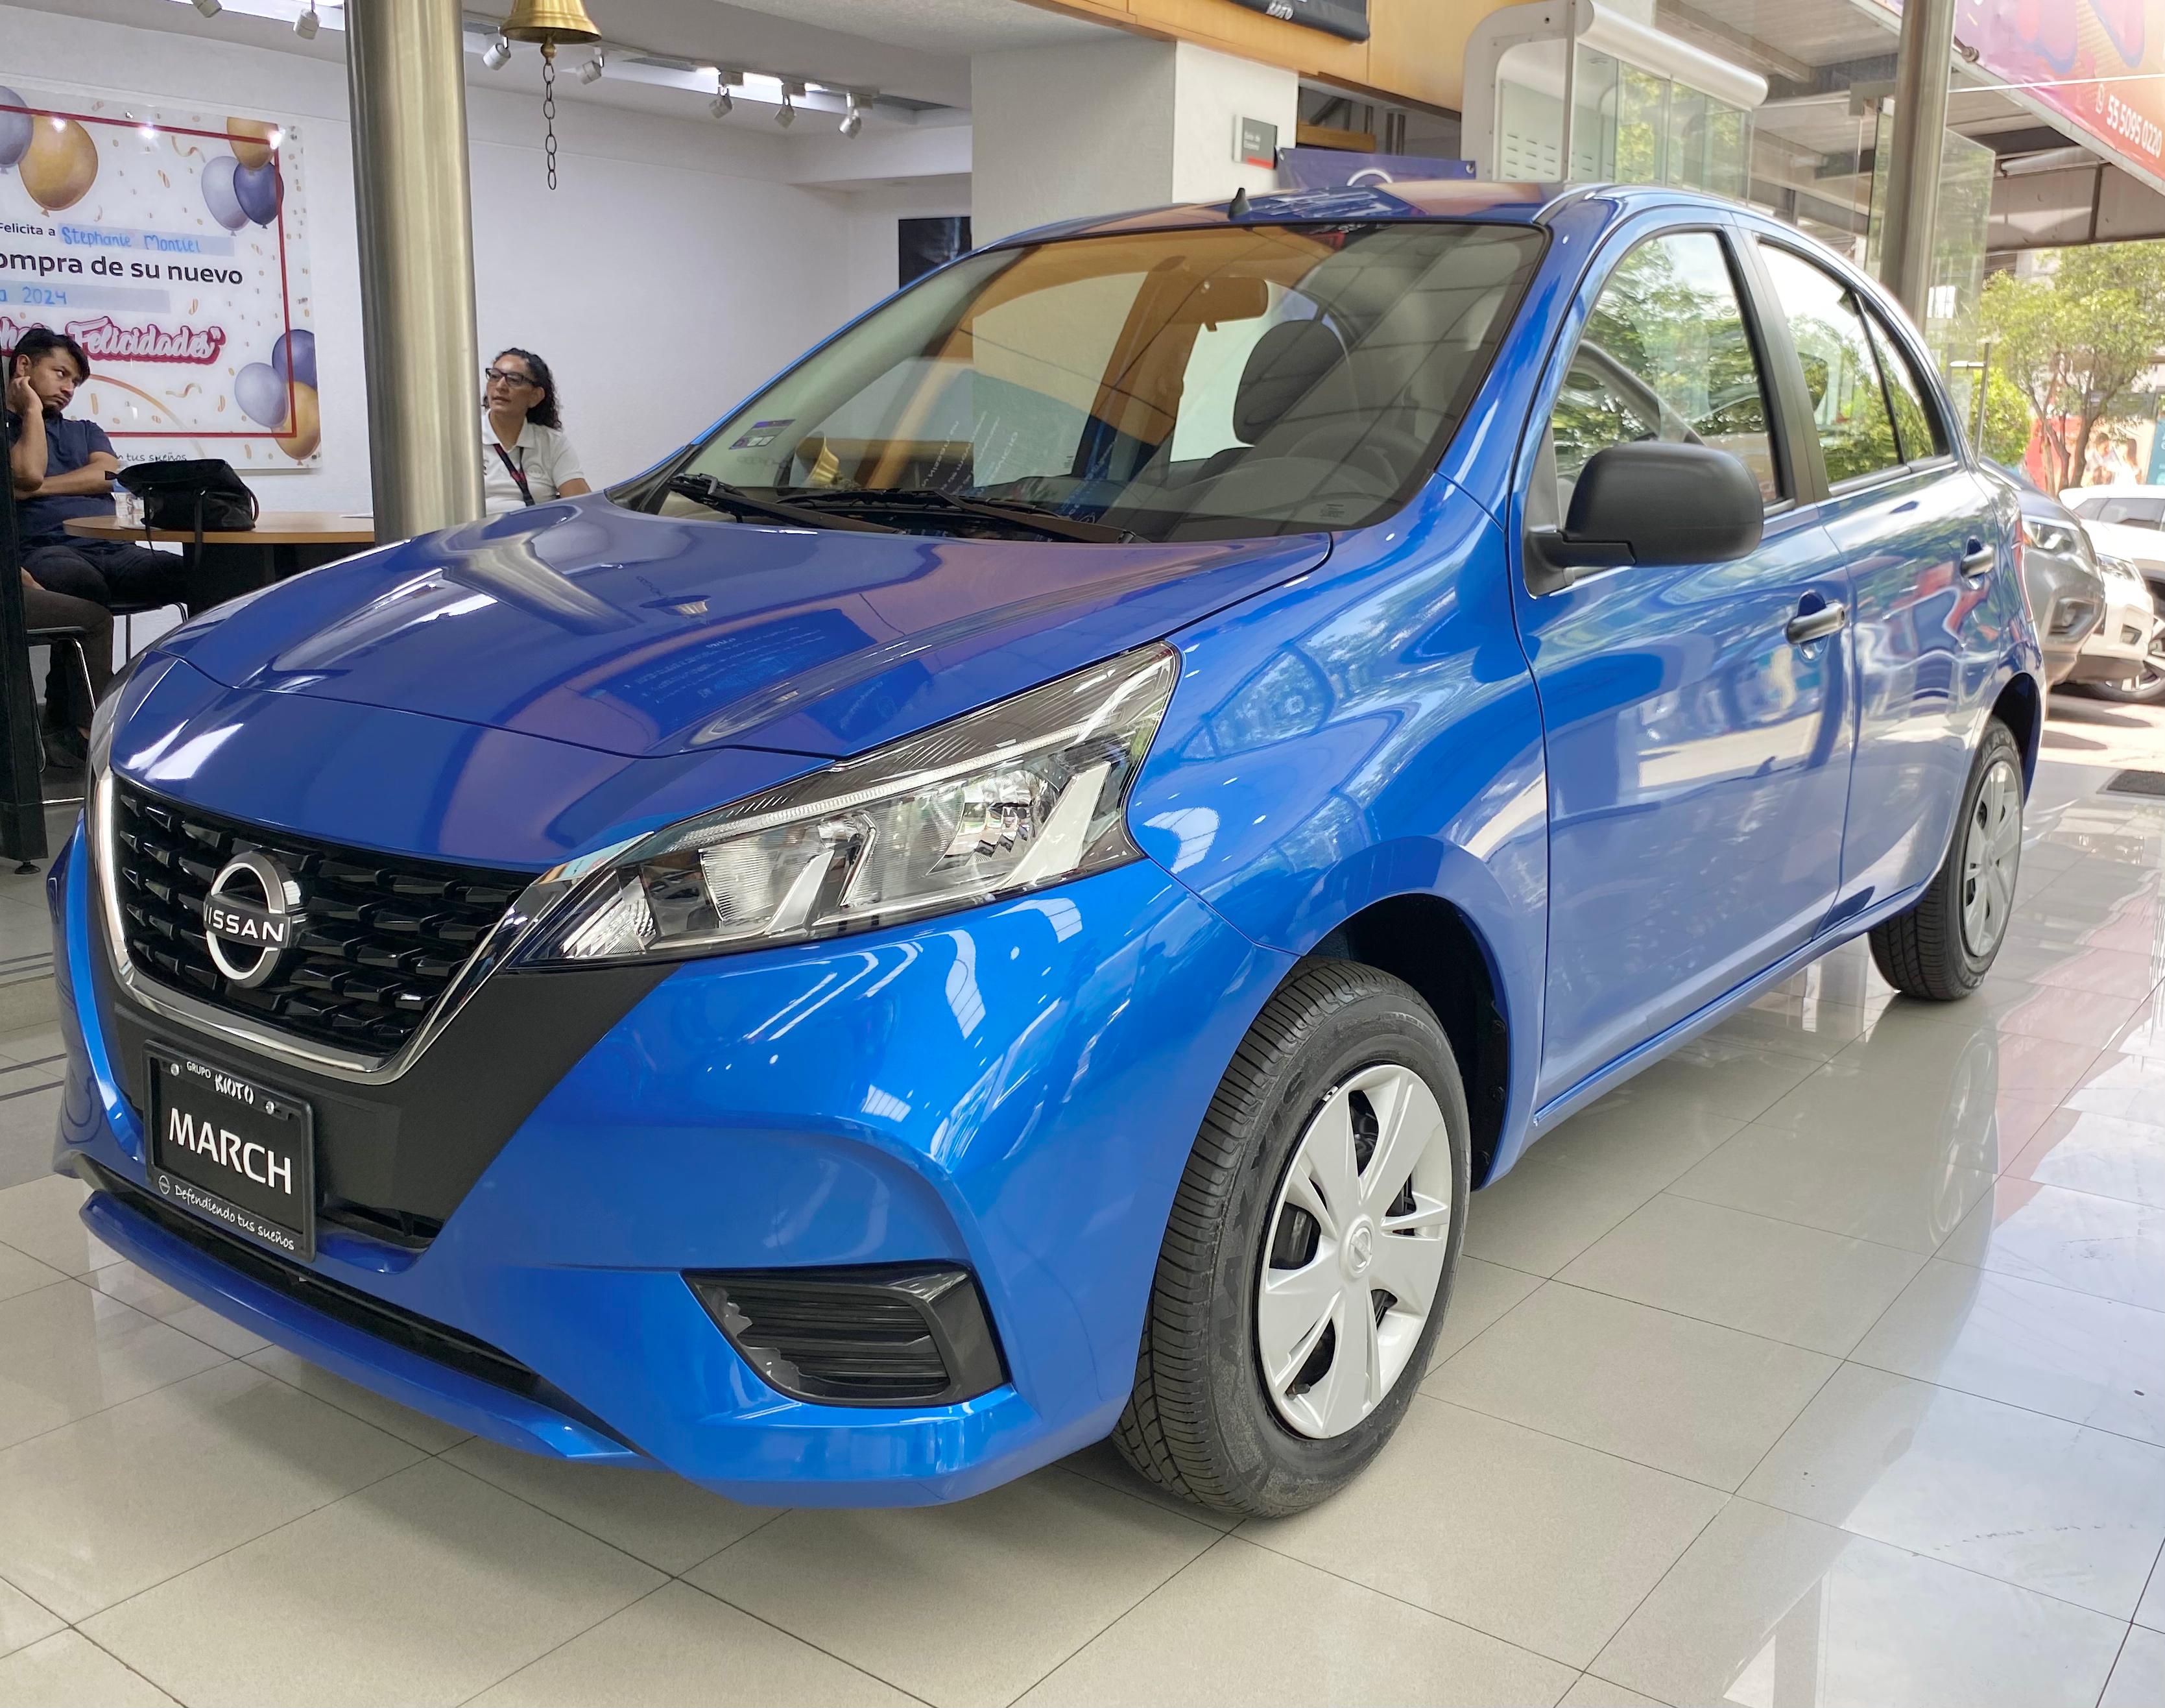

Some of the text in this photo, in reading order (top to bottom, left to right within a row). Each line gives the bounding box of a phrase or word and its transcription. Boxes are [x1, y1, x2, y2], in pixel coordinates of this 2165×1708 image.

[2106, 93, 2120, 130] 55
[48, 228, 56, 236] a
[62, 226, 132, 248] Stephanie
[91, 256, 123, 276] de
[131, 263, 160, 280] su
[167, 265, 243, 284] nuevo
[22, 285, 67, 305] 2024
[126, 453, 145, 461] tus
[203, 902, 284, 942] NISSAN
[187, 1061, 254, 1105] GRUPO KIOTO
[169, 1107, 291, 1195] MARCH
[174, 1185, 294, 1250] Defendiendo tus sueños
